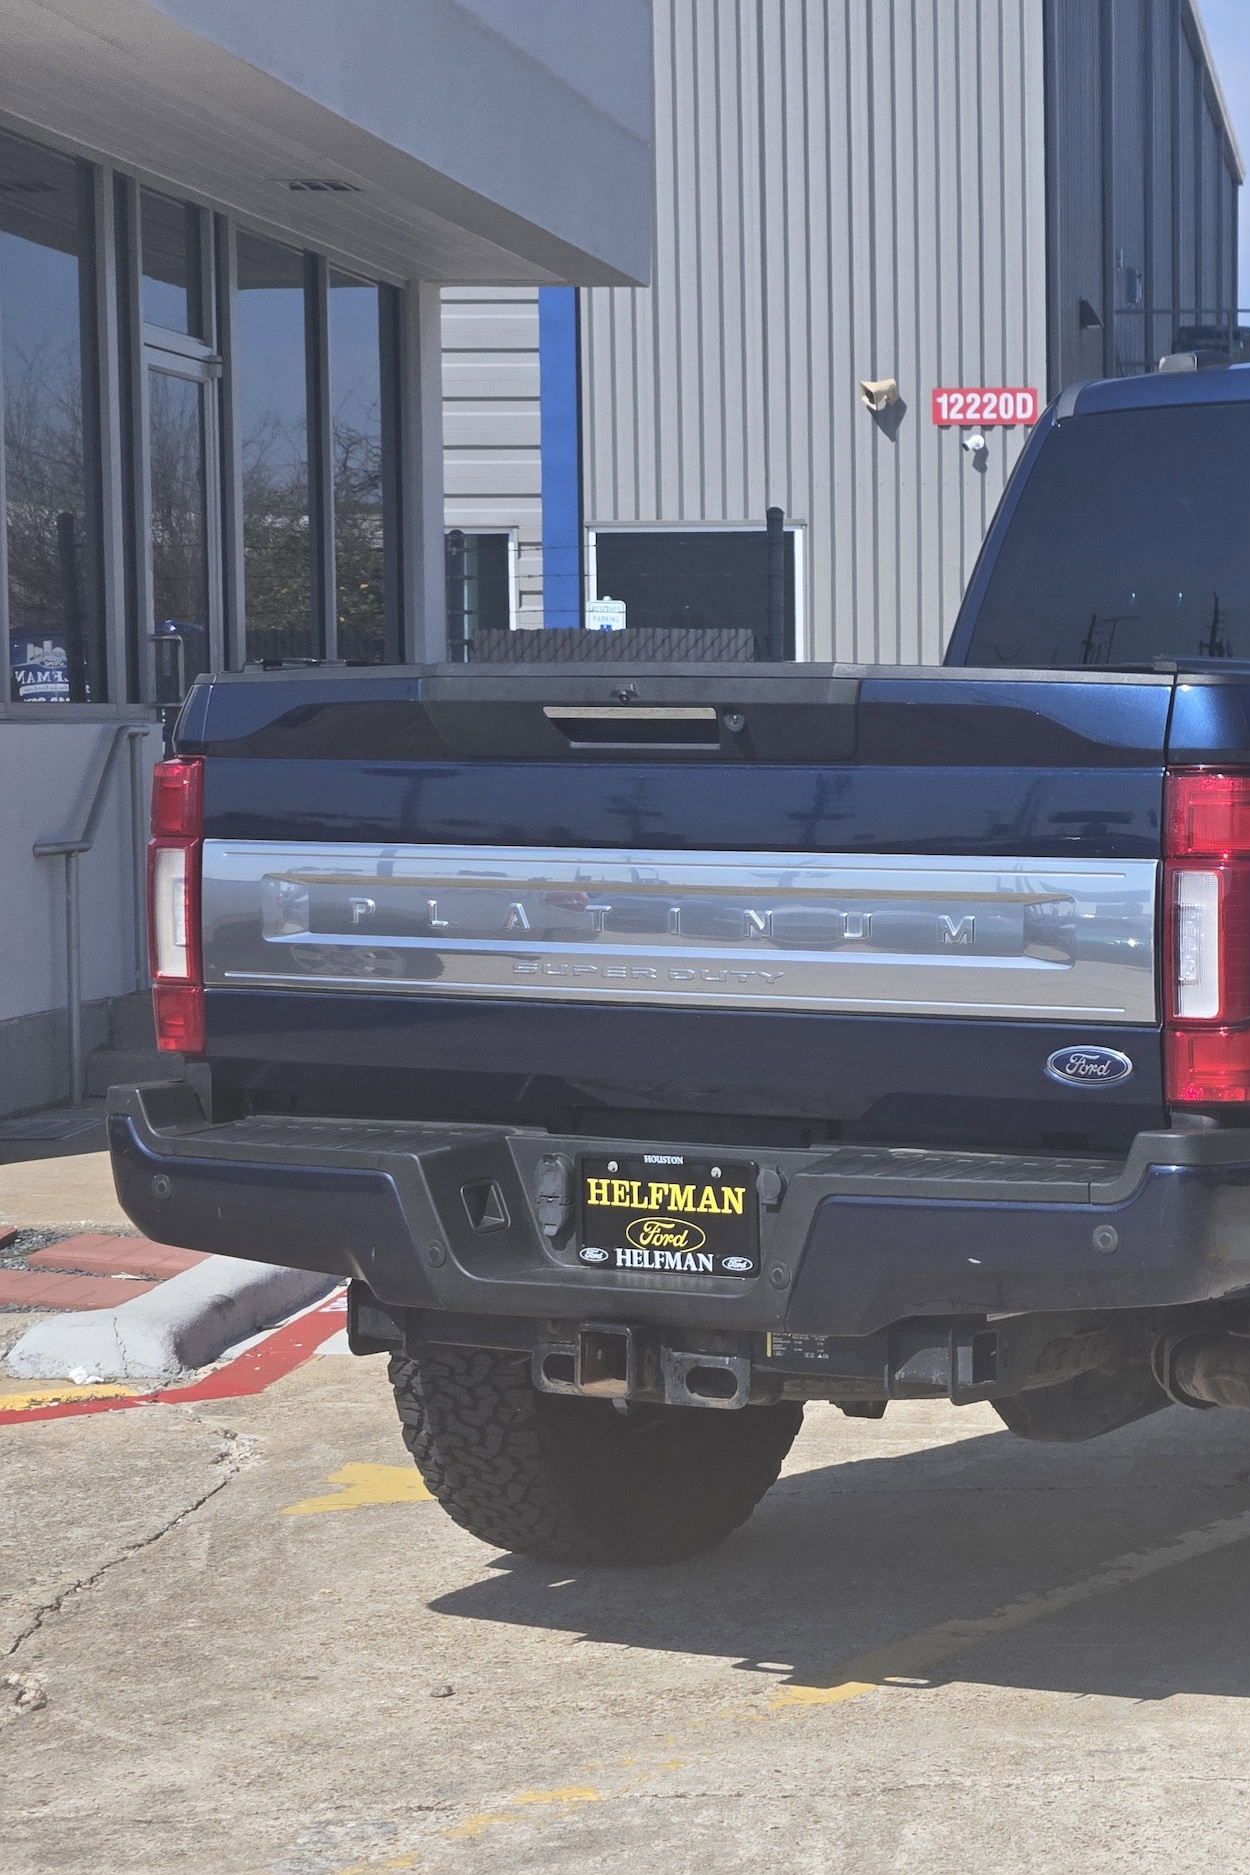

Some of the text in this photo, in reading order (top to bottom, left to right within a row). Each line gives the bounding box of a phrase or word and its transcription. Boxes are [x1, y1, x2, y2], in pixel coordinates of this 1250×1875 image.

[936, 392, 1034, 420] 12220D
[349, 897, 976, 945] PLATINUM
[513, 962, 785, 984] SUPER DUTY
[1065, 1053, 1112, 1076] Ford
[643, 1154, 684, 1166] HOUSTON
[586, 1177, 747, 1216] HELFMAN
[639, 1220, 690, 1249] Ford
[583, 1249, 605, 1261] Ford
[615, 1247, 715, 1273] HELFMAN
[726, 1257, 749, 1270] Ford
